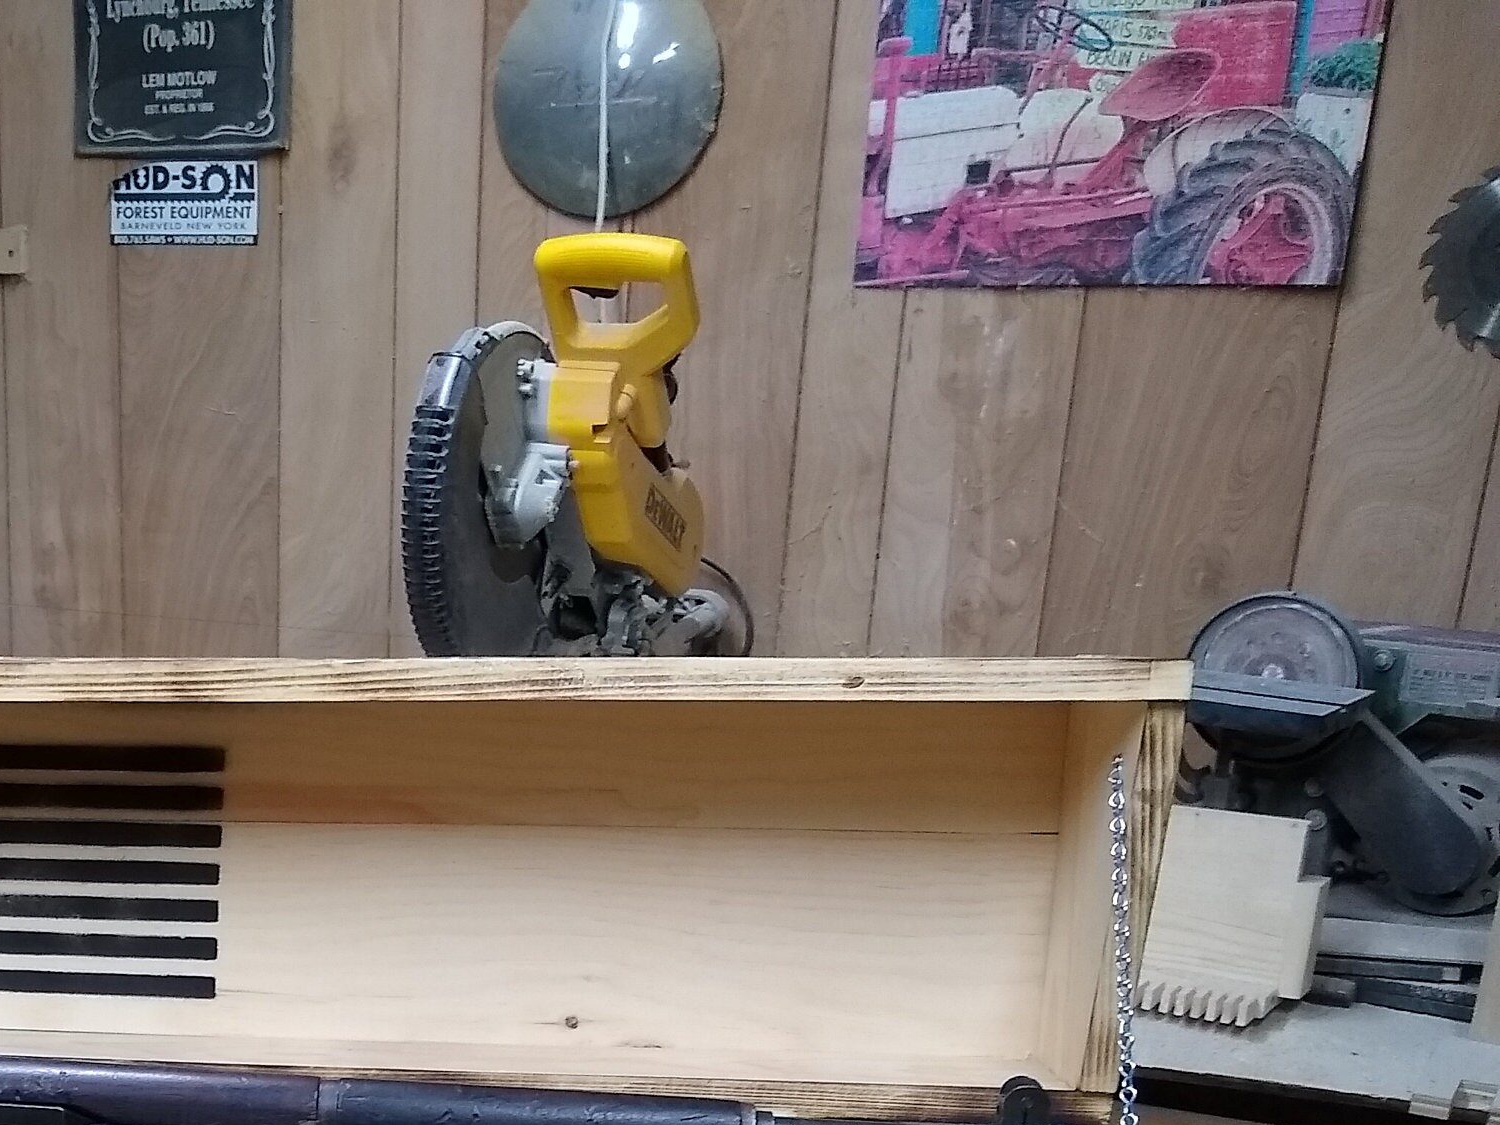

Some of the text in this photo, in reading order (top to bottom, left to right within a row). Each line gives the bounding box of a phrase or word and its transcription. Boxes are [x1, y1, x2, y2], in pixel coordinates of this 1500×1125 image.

[167, 70, 217, 86] MOTLOW
[116, 206, 252, 219] FOREST EQUIPMENT
[120, 222, 247, 230] BARNEVELD NEW YORK
